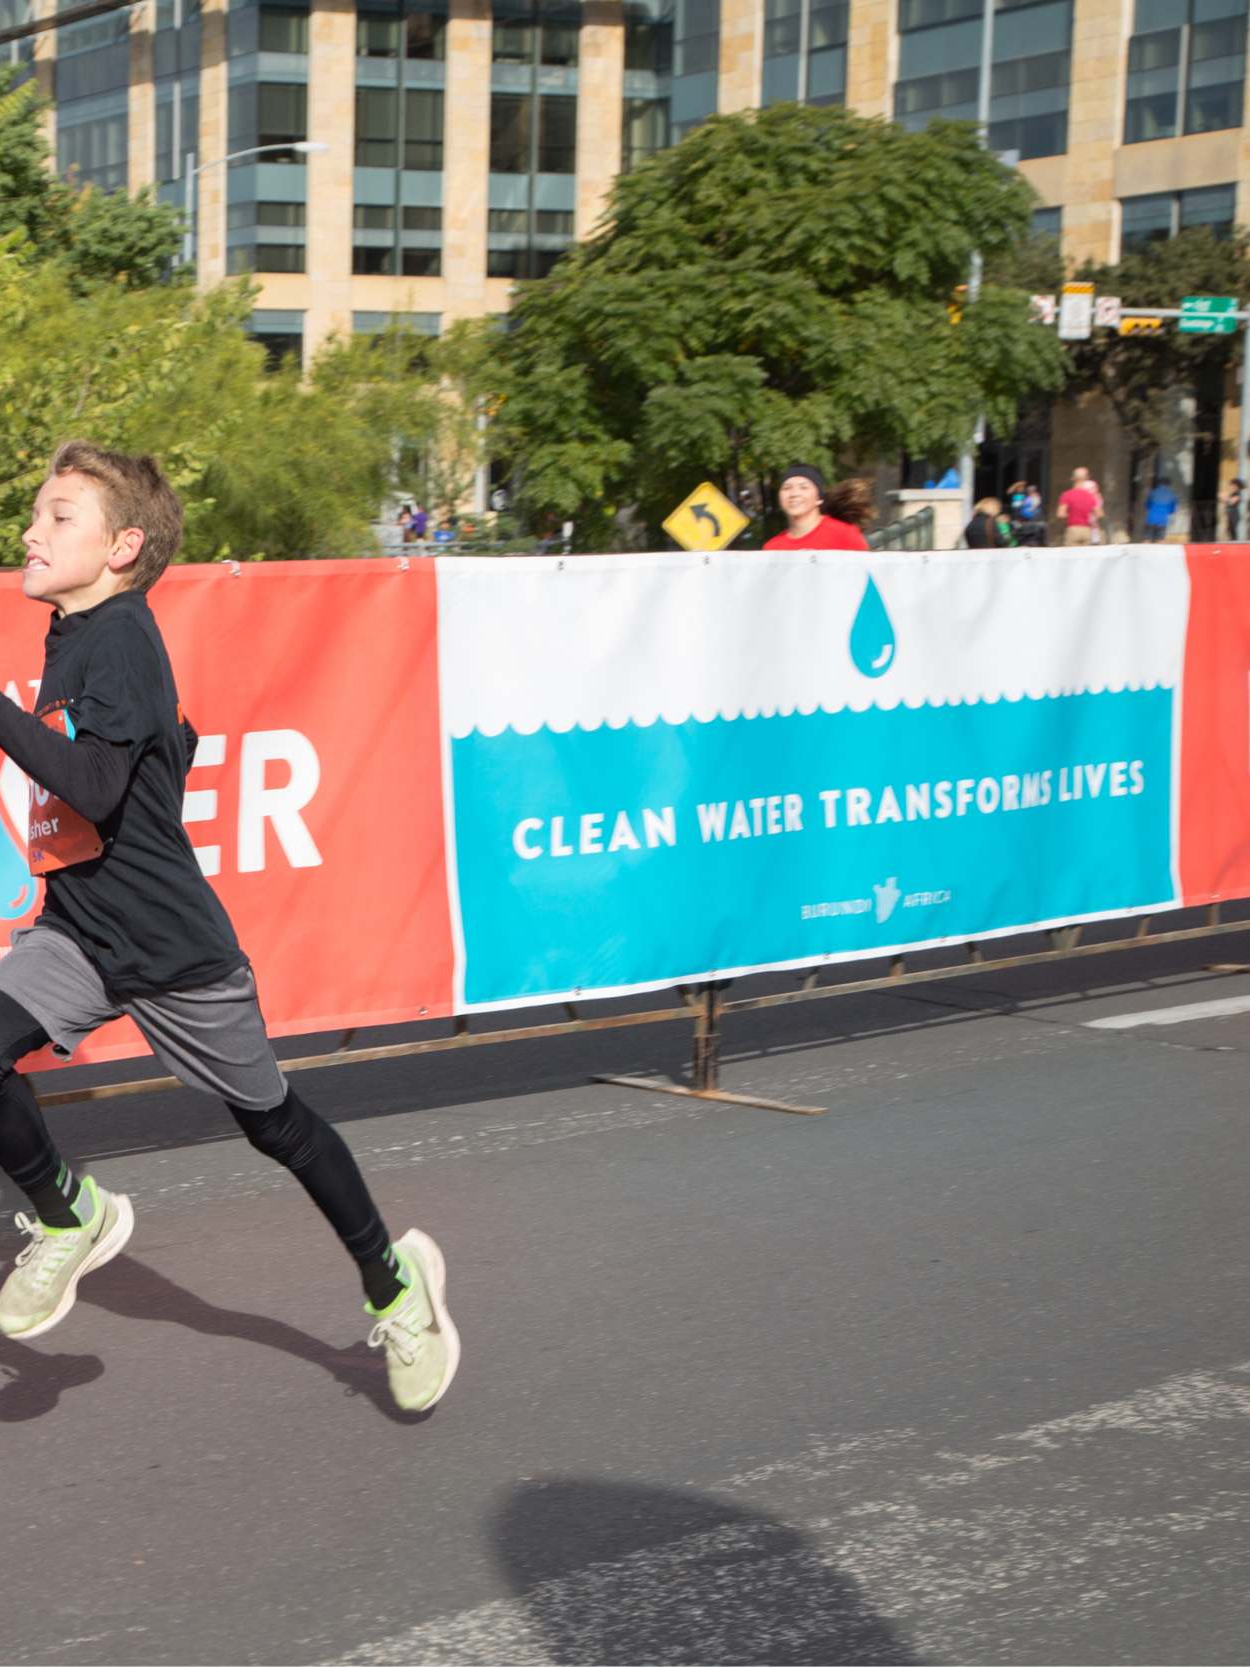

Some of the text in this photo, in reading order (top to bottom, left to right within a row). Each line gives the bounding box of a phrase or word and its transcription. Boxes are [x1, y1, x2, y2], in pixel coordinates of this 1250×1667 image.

[511, 759, 1145, 860] CLEAN WATER TRANSFORMS LIVES
[29, 817, 59, 841] sher
[32, 848, 46, 863] 5K
